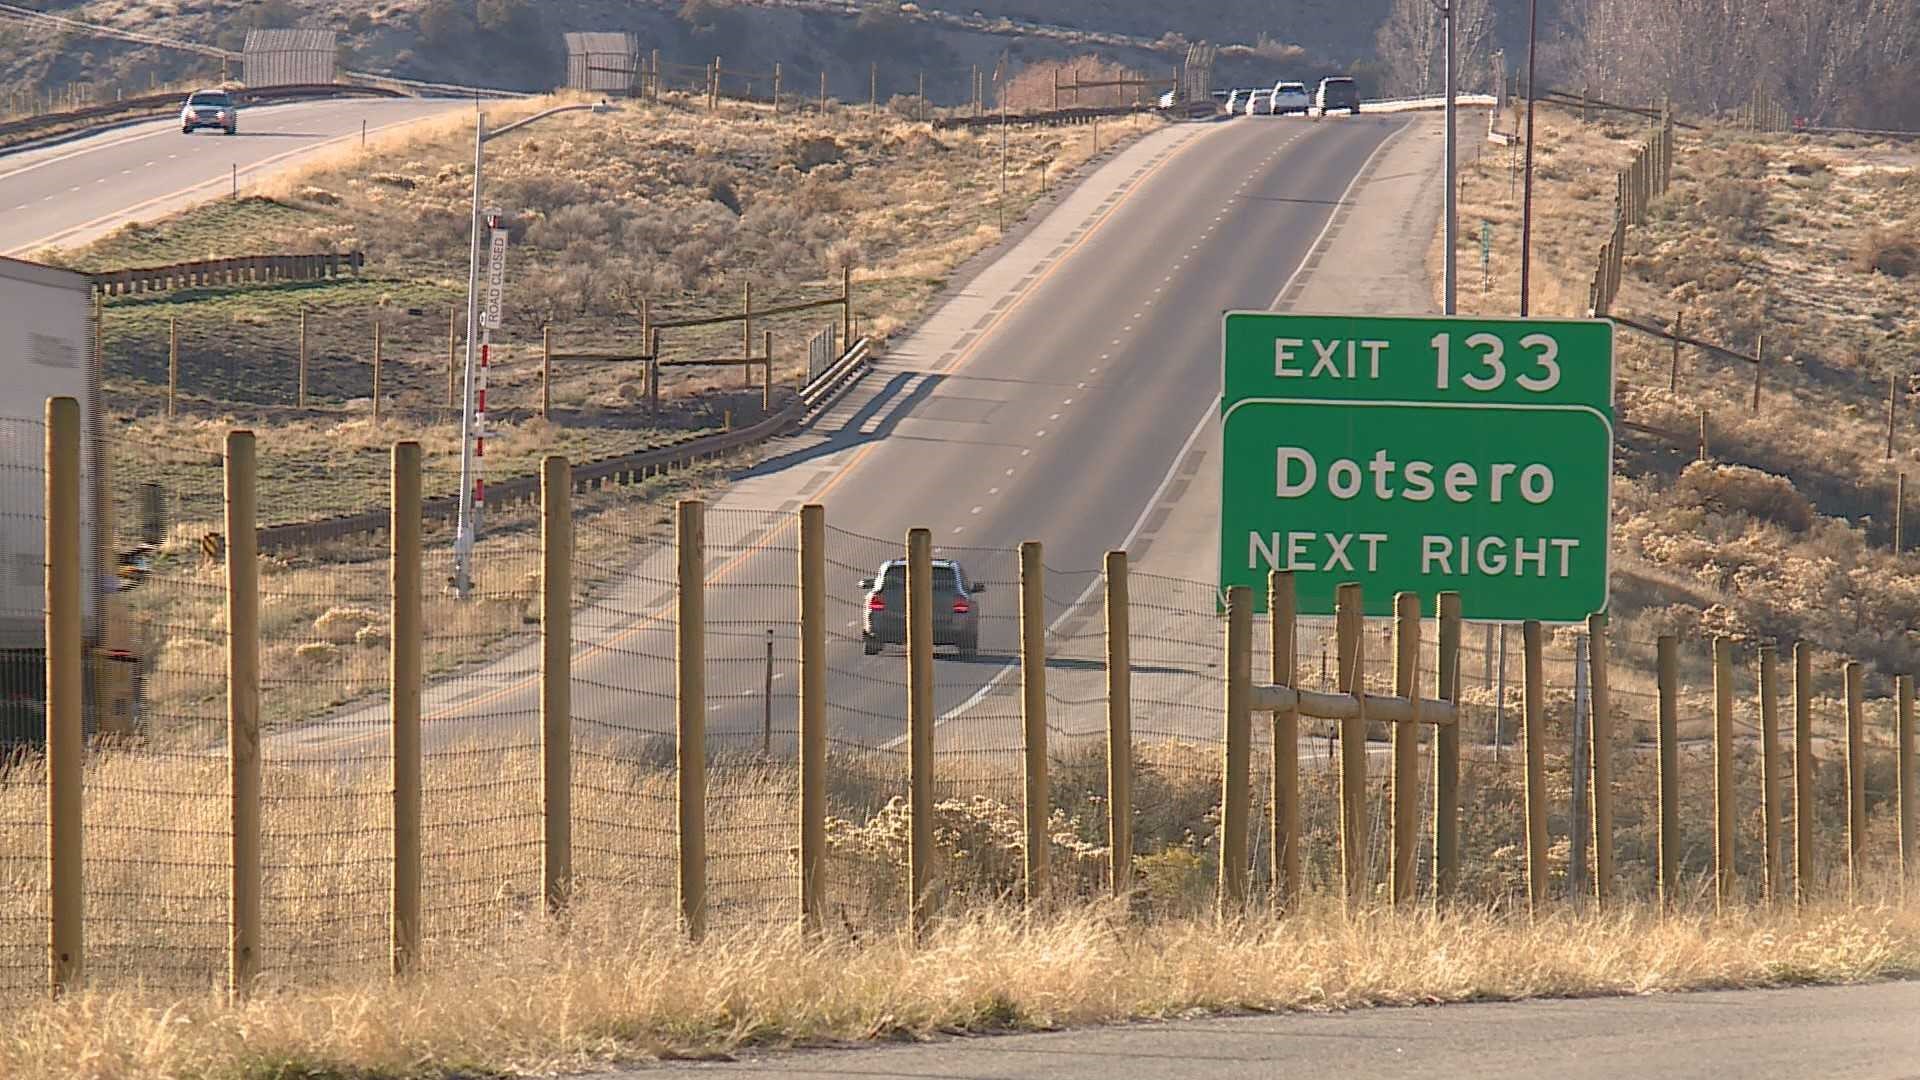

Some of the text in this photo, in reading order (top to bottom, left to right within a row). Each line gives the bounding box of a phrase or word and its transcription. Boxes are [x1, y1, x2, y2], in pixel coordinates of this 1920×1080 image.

[489, 238, 504, 322] ROAD CLOSED
[1274, 332, 1562, 392] EXIT 133
[1275, 446, 1555, 504] Dotsero
[1248, 531, 1580, 577] NEXT RIGHT
